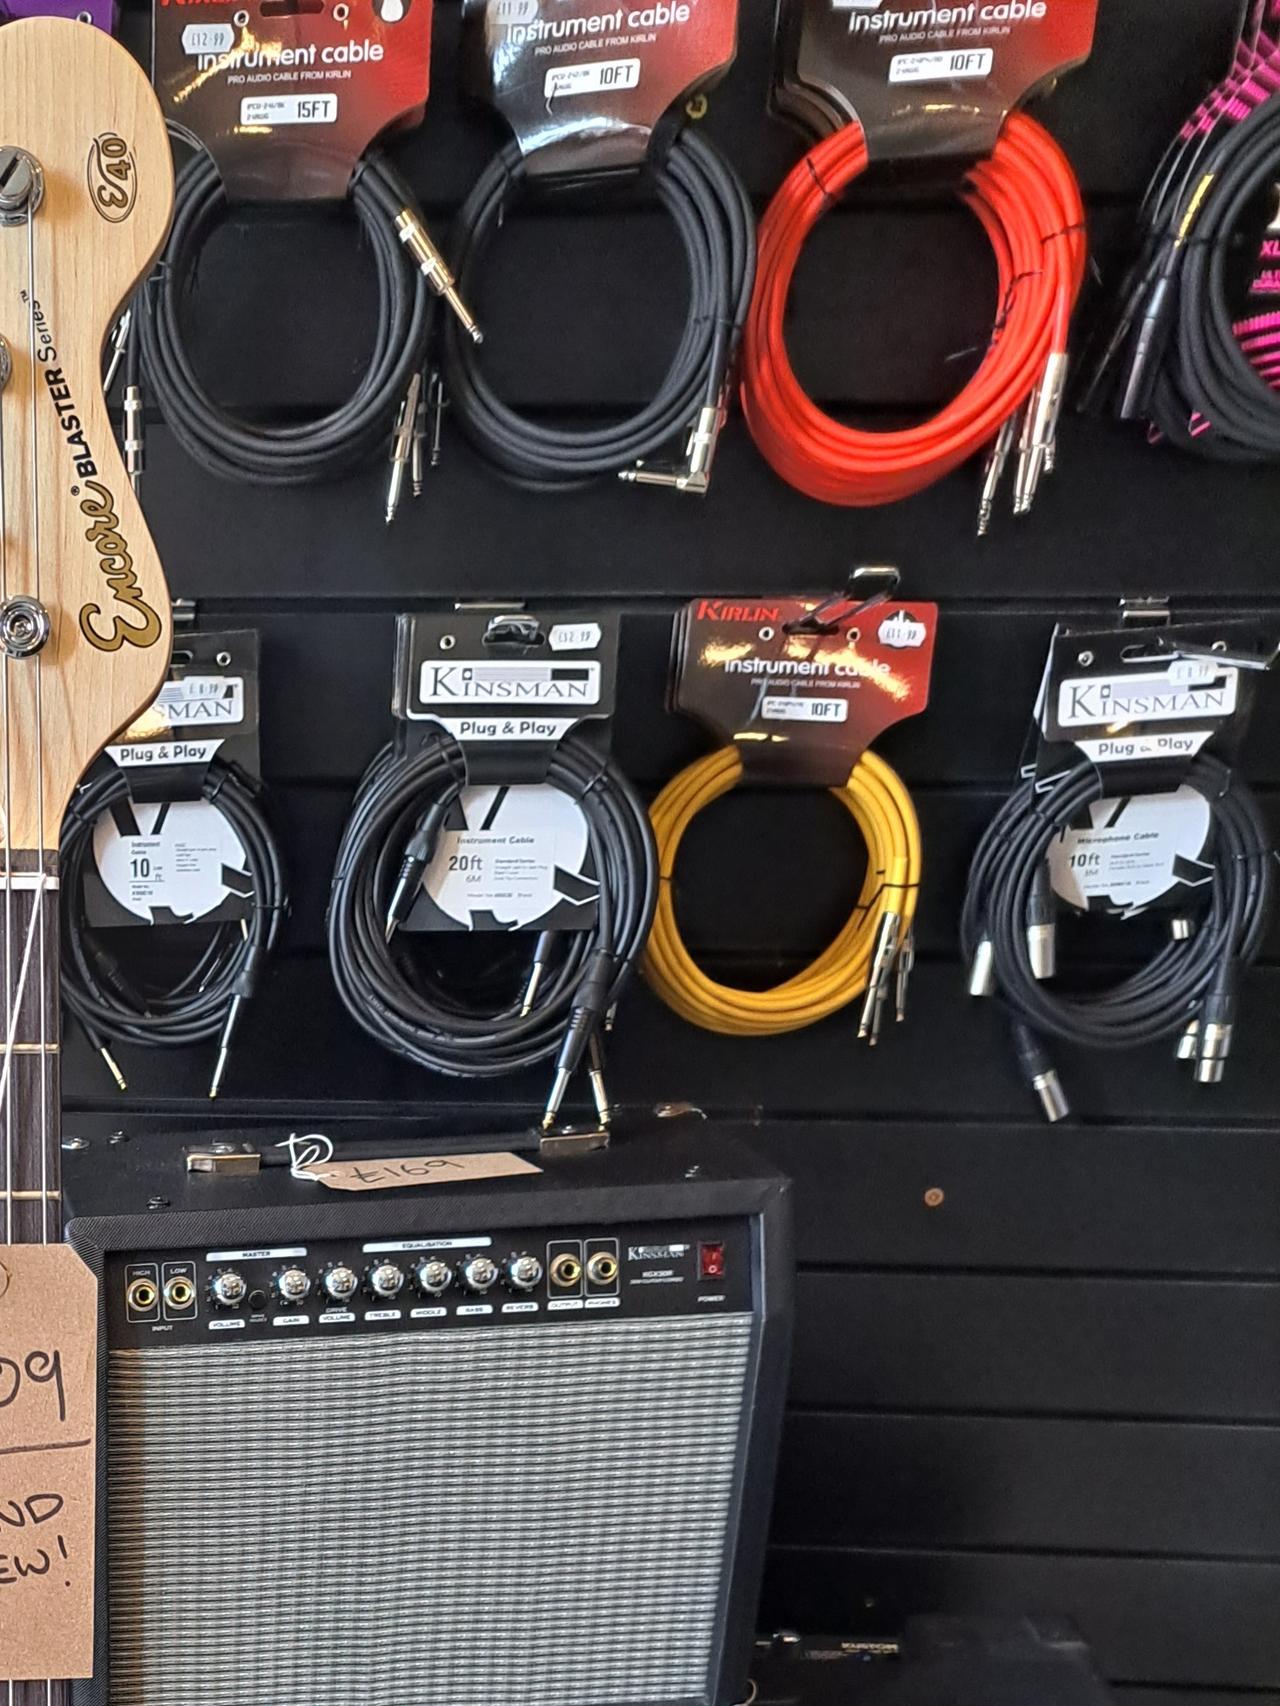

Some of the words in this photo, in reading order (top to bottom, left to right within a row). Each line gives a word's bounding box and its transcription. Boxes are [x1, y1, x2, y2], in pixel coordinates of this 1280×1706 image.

[506, 8, 622, 43] instrument
[628, 2, 690, 28] cable
[849, 4, 974, 31] instrument
[980, 0, 1046, 20] cable
[321, 39, 384, 64] cable
[553, 42, 578, 55] AUDIO
[578, 39, 604, 52] CABLE
[605, 36, 629, 49] FROM
[950, 54, 986, 72] 10FT
[227, 74, 246, 85] PRO
[246, 73, 272, 83] AUDIO
[273, 72, 299, 82] CABLE
[300, 71, 324, 81] FROM
[325, 70, 352, 80] KIRLIN
[600, 65, 634, 86] 10FT
[297, 100, 331, 119] 15FT
[44, 367, 99, 478] BLASTER
[697, 601, 780, 622] KIRLIN
[725, 657, 830, 676] instrument
[429, 666, 589, 698] KINSMAN
[811, 702, 843, 717] 10FT
[1067, 684, 1225, 720] KINSMAN
[460, 720, 497, 737] Plug
[502, 720, 514, 734] &
[519, 720, 557, 736] Play
[120, 746, 154, 763] Plug
[160, 746, 169, 760] &
[173, 744, 207, 760] Play
[1099, 741, 1135, 756] Plug
[130, 858, 150, 878] 10
[349, 1159, 465, 1184] £169
[170, 1267, 187, 1275] LOW
